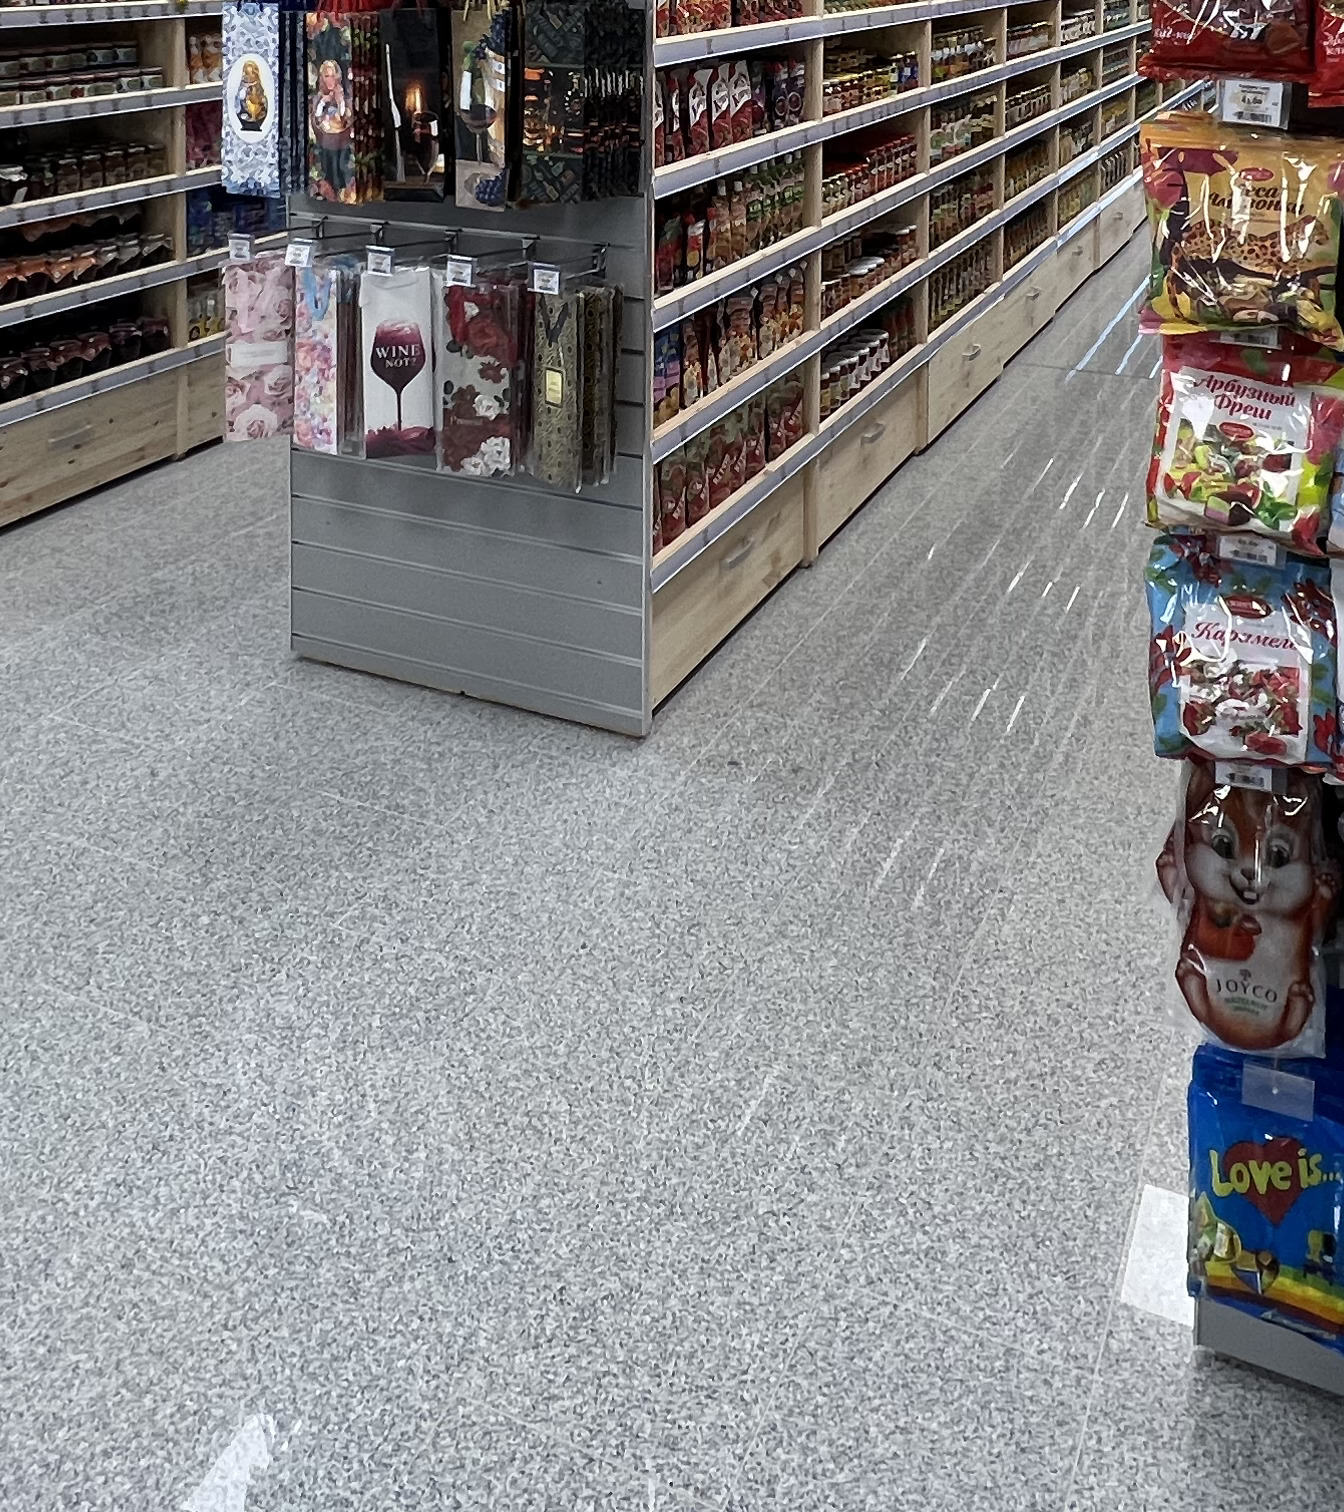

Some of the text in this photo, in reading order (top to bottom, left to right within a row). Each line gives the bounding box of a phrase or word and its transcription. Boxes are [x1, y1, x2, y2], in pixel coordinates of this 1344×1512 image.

[376, 343, 422, 359] WINE
[1194, 373, 1297, 409] Арбузный
[1213, 394, 1273, 421] Фреш
[1215, 976, 1278, 1006] JOYCO
[1209, 1149, 1293, 1198] Love
